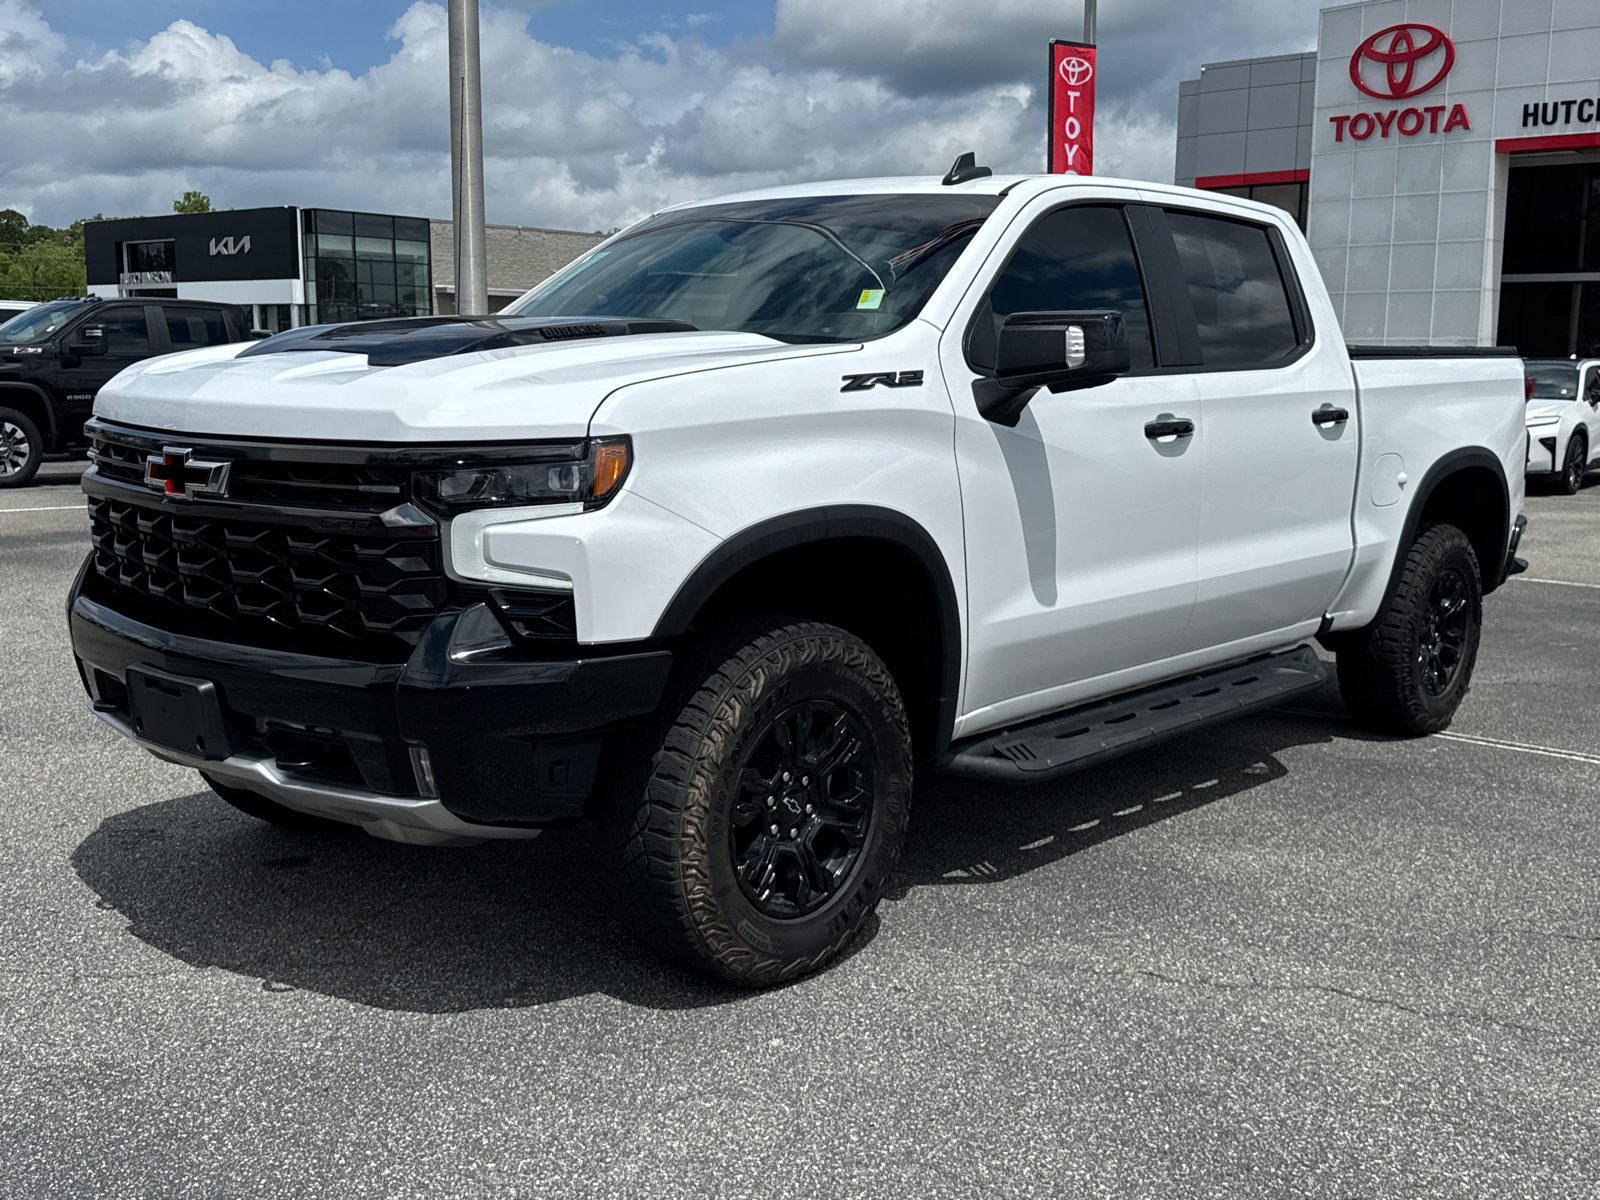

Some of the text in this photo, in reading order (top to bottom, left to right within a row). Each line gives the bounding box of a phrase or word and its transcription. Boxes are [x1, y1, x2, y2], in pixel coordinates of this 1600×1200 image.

[1329, 103, 1472, 142] TOYOTA
[1521, 98, 1600, 127] HUTC
[1063, 90, 1081, 175] TOY
[209, 235, 251, 256] KIA
[119, 271, 172, 285] HUTCHINSON
[840, 370, 925, 394] ZR2
[710, 680, 793, 845] WRANGLER
